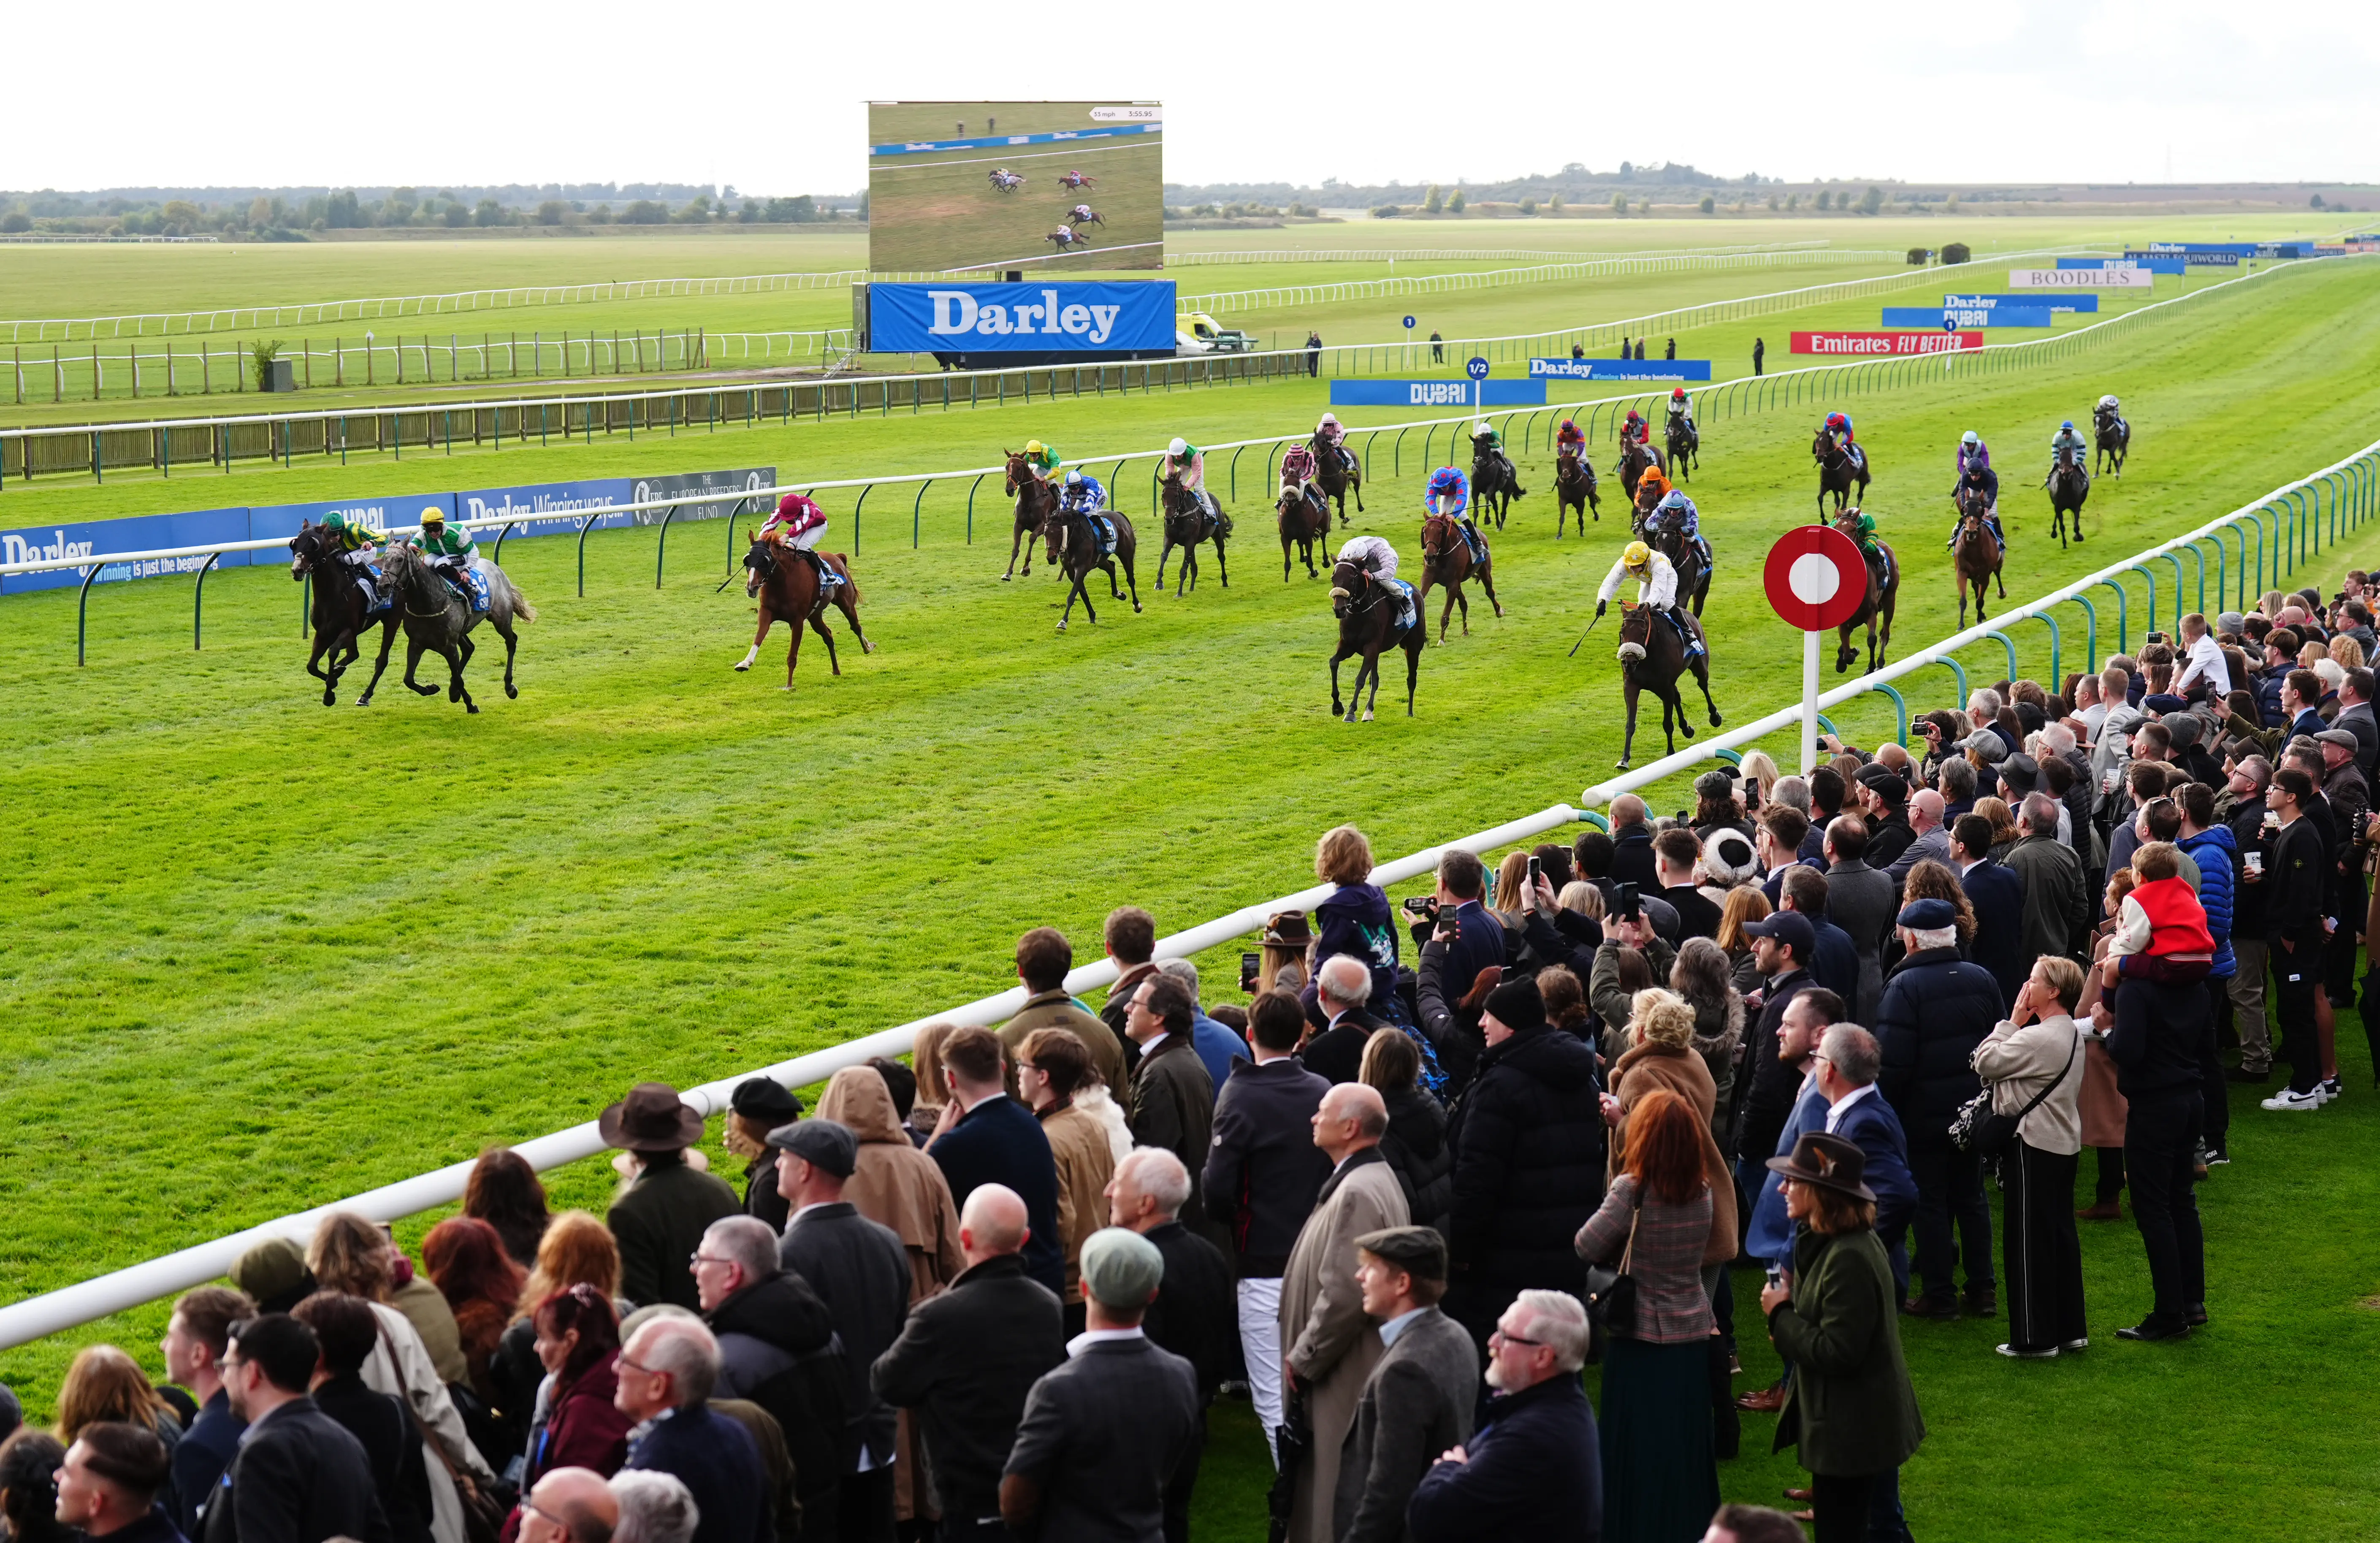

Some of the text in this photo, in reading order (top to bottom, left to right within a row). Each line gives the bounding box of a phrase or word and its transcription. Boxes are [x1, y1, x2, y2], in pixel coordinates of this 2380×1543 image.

[2032, 271, 2130, 285] BOODLES
[1945, 295, 1998, 308] Darley
[928, 290, 1120, 343] Darley
[1811, 335, 1963, 353] Emirates FLY BETTER
[1469, 363, 1487, 374] 1/2
[1530, 359, 1593, 378] Darley
[1410, 383, 1466, 405] DUBAI
[702, 475, 711, 485] THE
[468, 494, 530, 535] Darley
[534, 492, 583, 529] Winning
[697, 505, 718, 520] FUND
[2, 530, 92, 578] Darley
[94, 562, 131, 581] Winning
[133, 561, 141, 576] is
[142, 559, 160, 578] just
[161, 558, 175, 572] the
